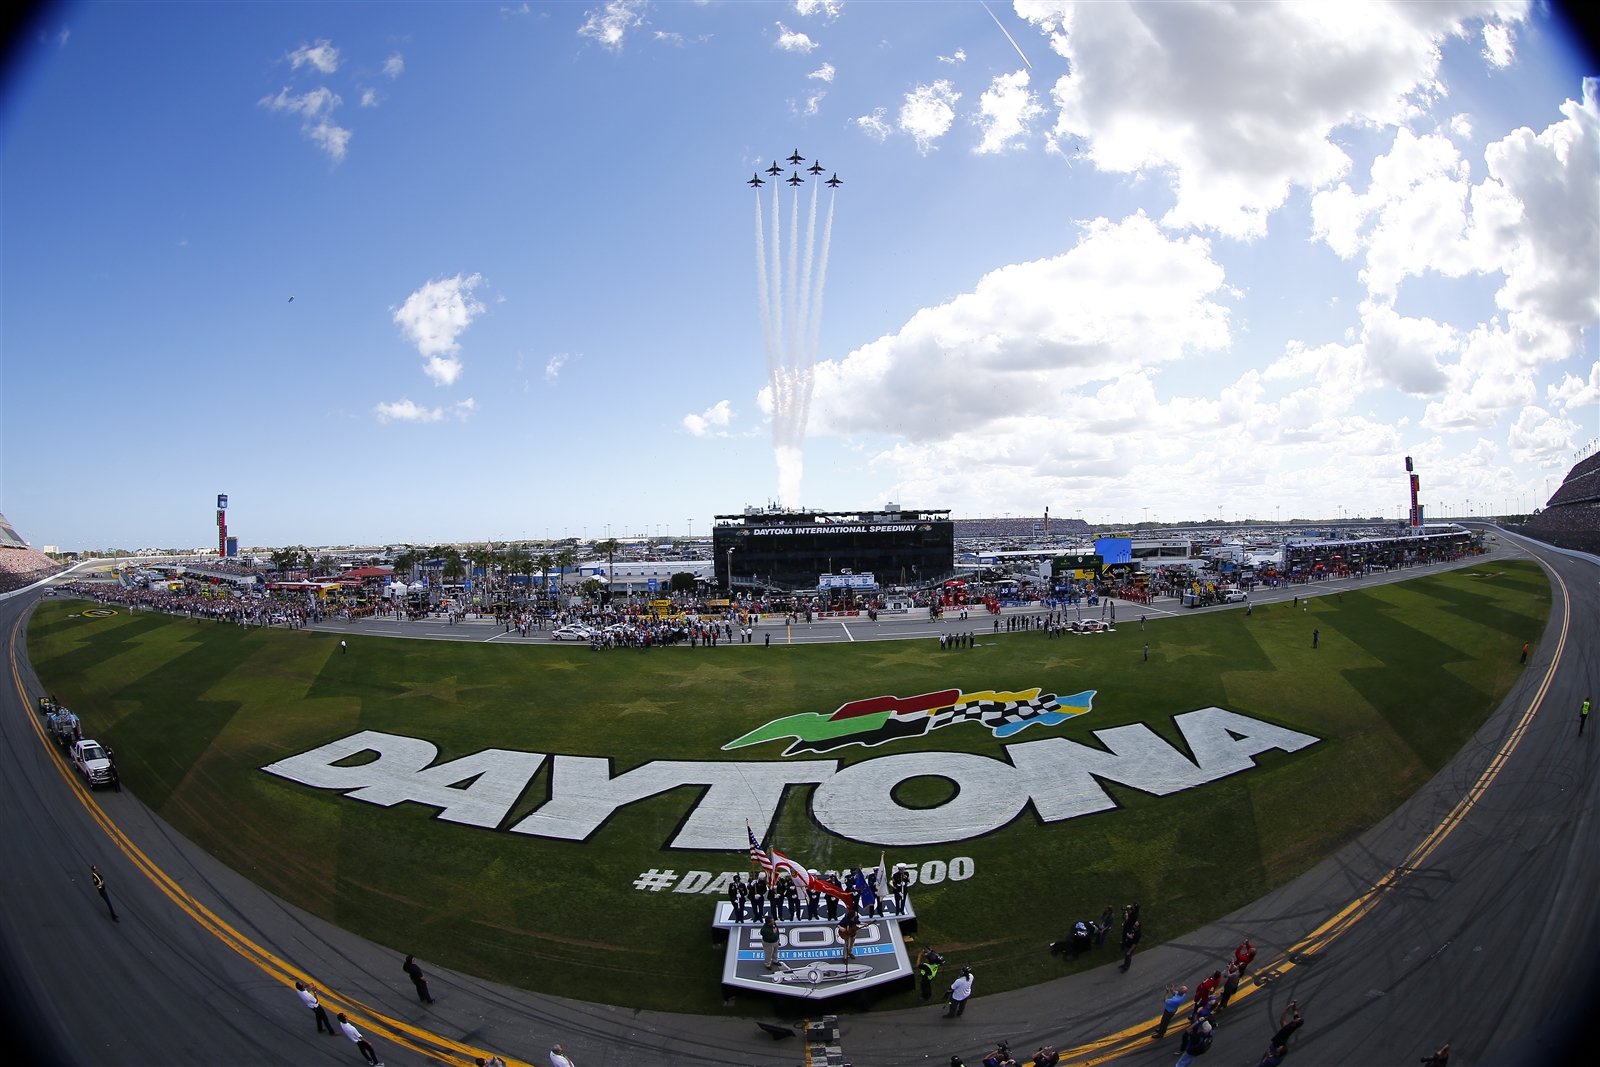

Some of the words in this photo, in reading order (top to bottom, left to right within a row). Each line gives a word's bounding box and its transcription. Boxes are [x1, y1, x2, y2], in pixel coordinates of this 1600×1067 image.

[753, 528, 793, 536] DAYTONA
[795, 526, 867, 535] INTERNATIONAL
[869, 525, 917, 533] SPEEDWAY
[261, 706, 1322, 849] DAYTONA
[633, 856, 975, 894] #DA500
[863, 946, 880, 954] 2015
